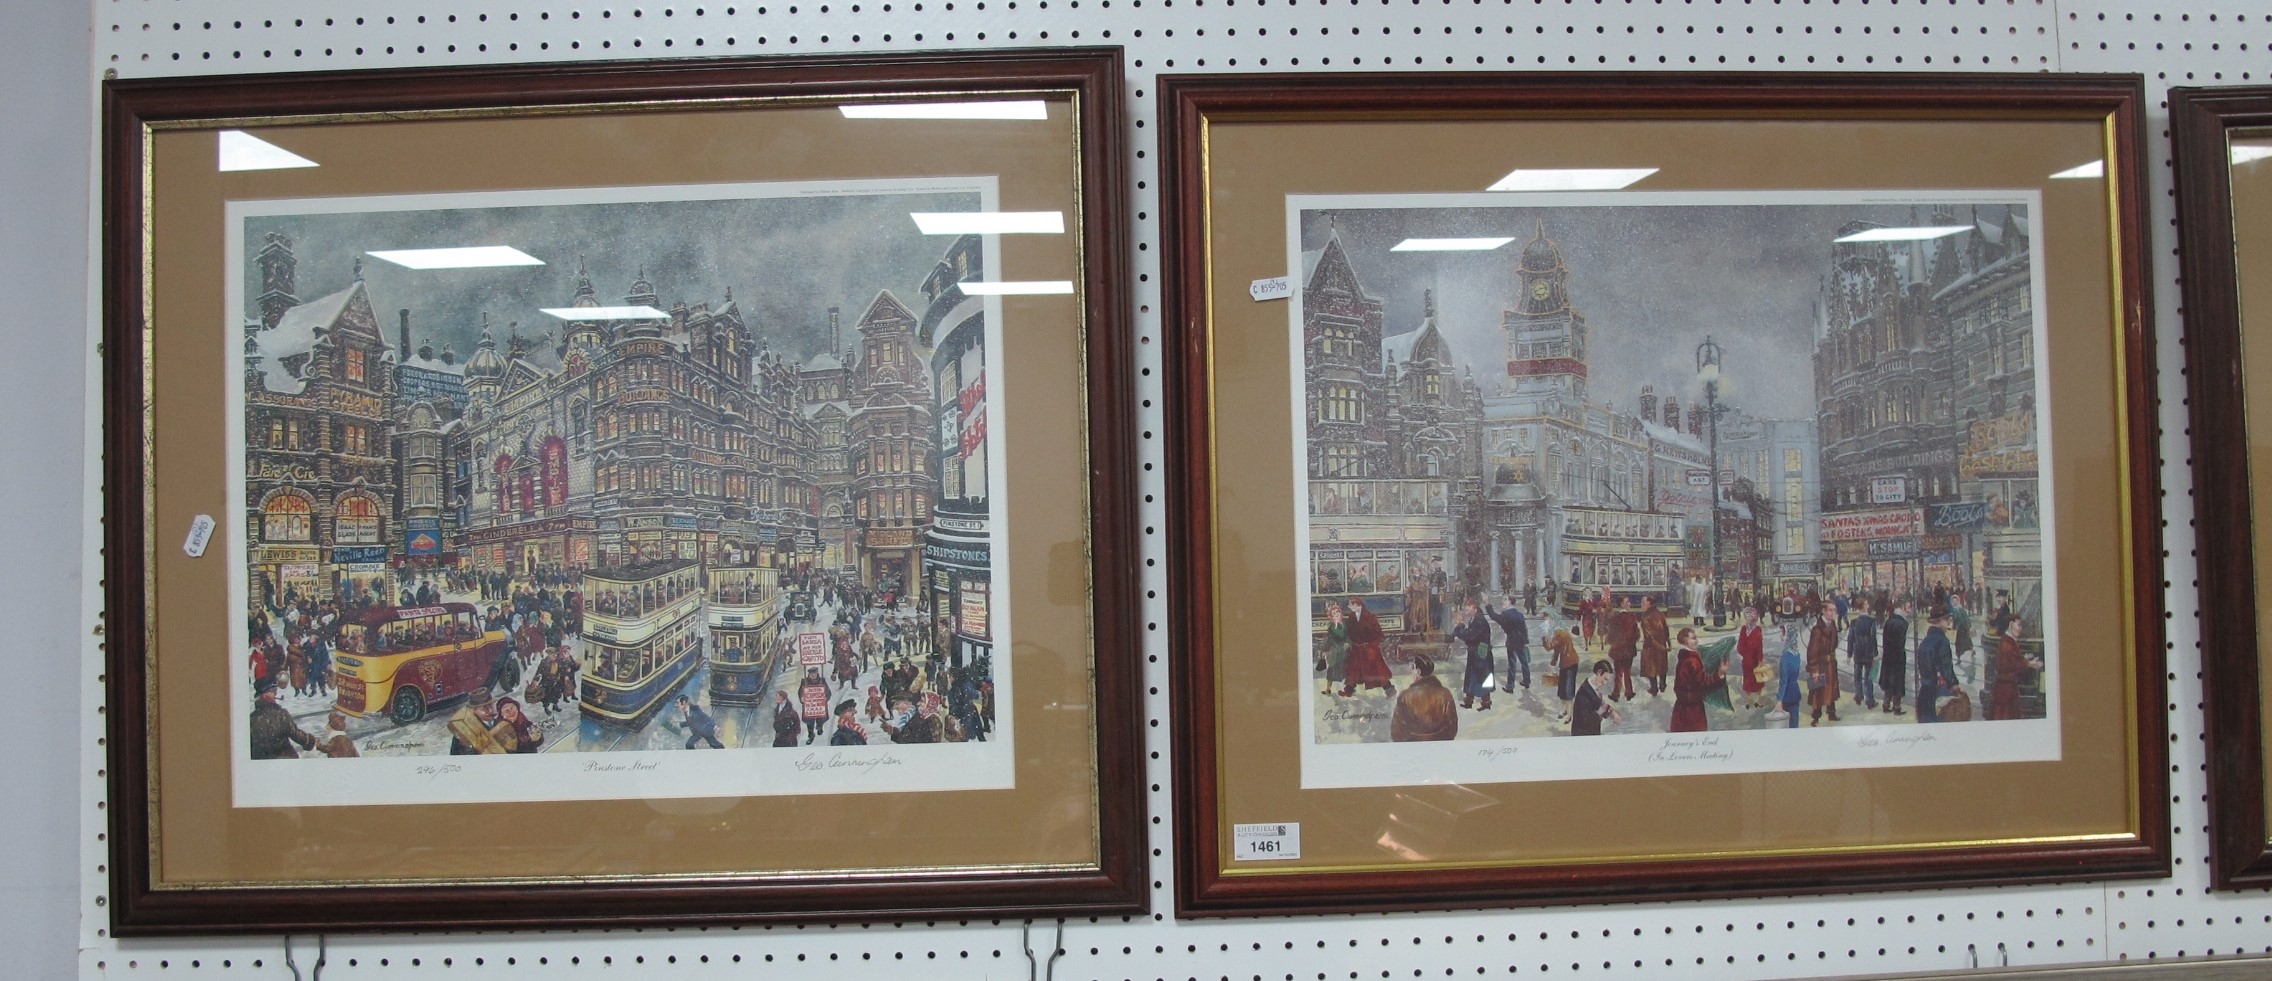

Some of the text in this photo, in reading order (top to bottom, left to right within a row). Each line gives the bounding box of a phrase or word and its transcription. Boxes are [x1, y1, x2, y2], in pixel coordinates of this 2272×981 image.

[330, 387, 382, 408] PYRAMID
[483, 525, 544, 542] CINDERELLA
[926, 544, 988, 561] SHIPSTONES
[1251, 841, 1280, 852] 1461
